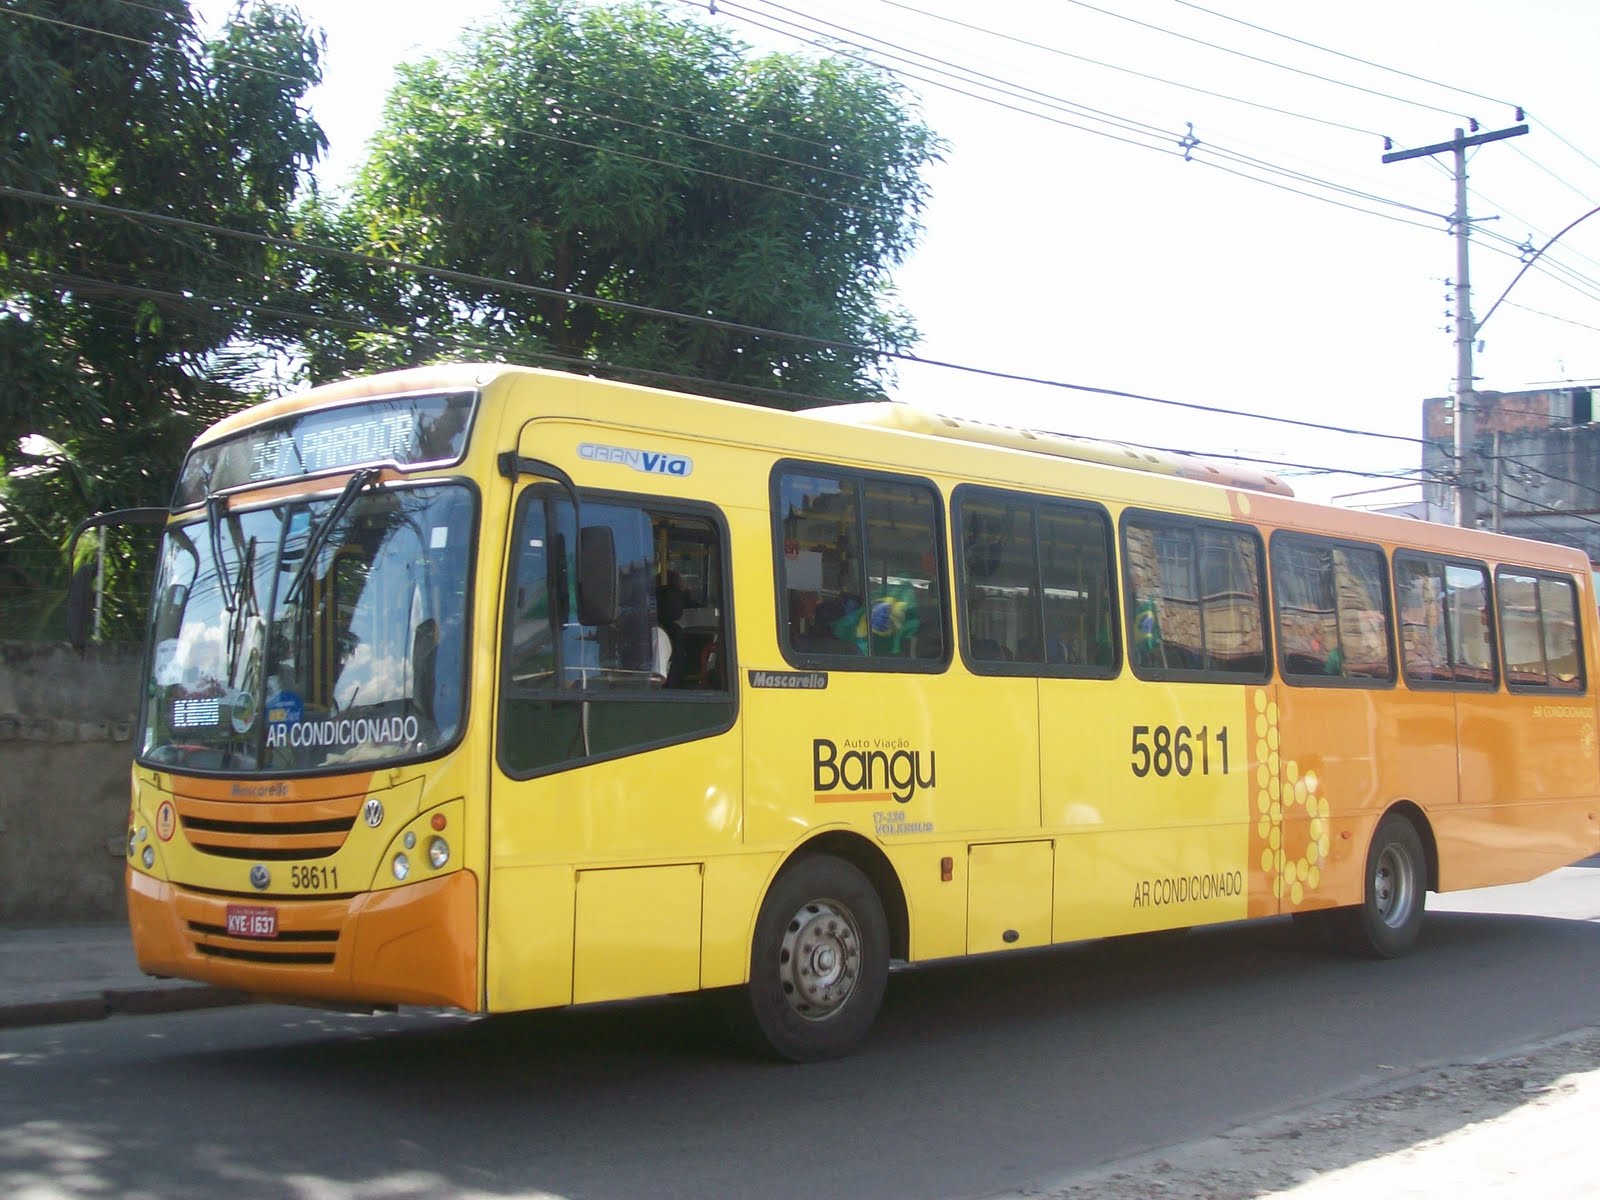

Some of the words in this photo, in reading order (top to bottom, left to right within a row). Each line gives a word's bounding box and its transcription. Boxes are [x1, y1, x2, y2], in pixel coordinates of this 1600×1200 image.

[301, 413, 413, 471] PARADOR
[642, 452, 686, 475] Via
[752, 671, 826, 689] Mascarello
[266, 723, 288, 748] AR
[290, 715, 419, 748] CONDICIONADO
[843, 738, 870, 748] Auto
[873, 738, 910, 750] Viação
[1131, 724, 1229, 778] 58611
[813, 738, 936, 804] Bangu
[291, 866, 338, 889] 58611
[1133, 881, 1150, 908] AR
[1153, 871, 1242, 905] CONDICIONADO
